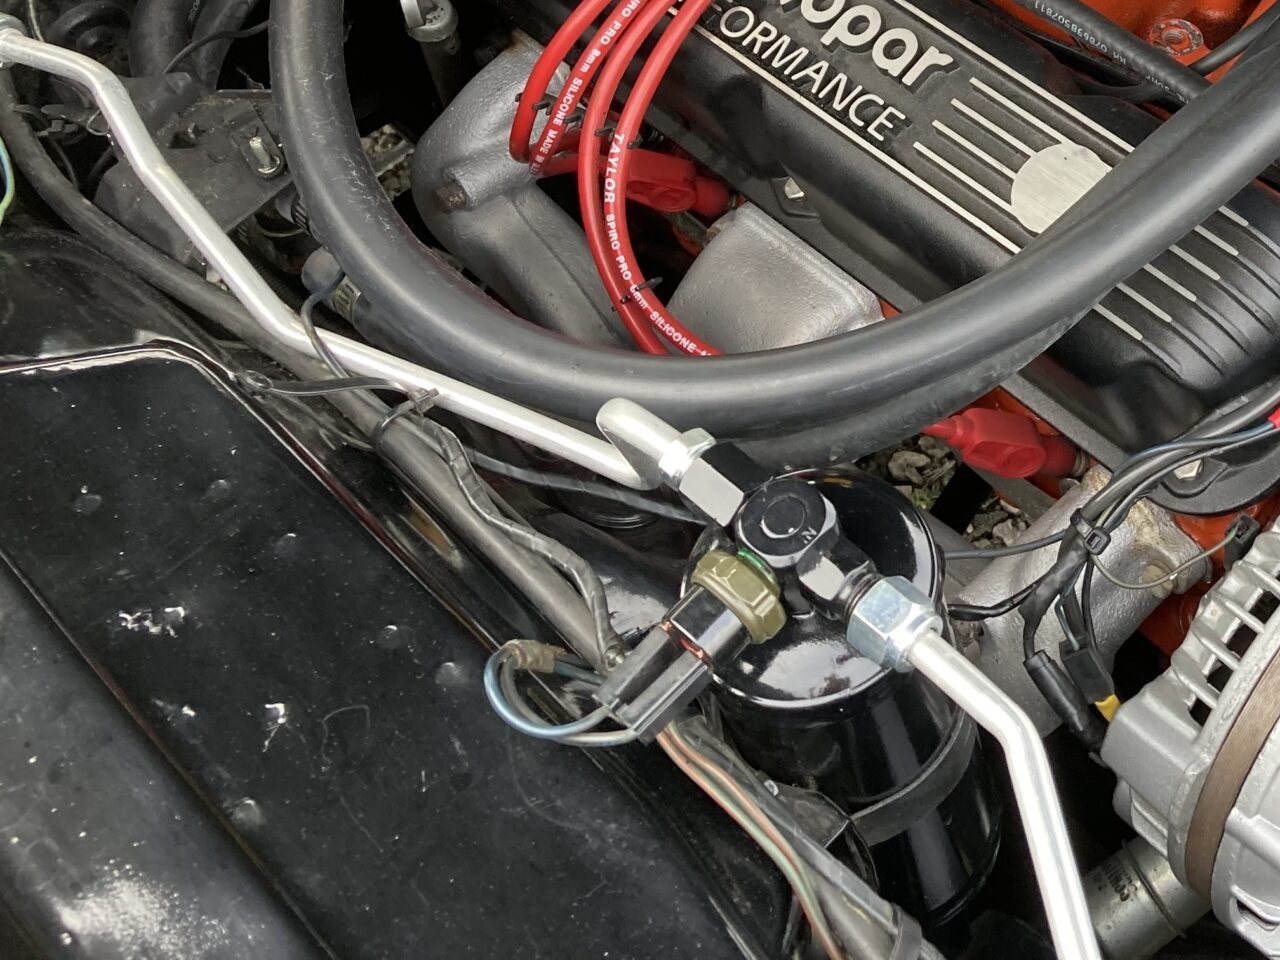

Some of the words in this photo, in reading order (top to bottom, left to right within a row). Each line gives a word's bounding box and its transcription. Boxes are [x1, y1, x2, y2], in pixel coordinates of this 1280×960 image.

[600, 21, 623, 46] PRO
[579, 49, 602, 73] 8mm
[553, 77, 584, 127] SILICONE
[539, 130, 559, 156] MADE
[604, 133, 625, 204] TAYLOR
[606, 213, 621, 251] SPIRO
[616, 256, 633, 281] PRO
[649, 309, 698, 354] SILICONE
